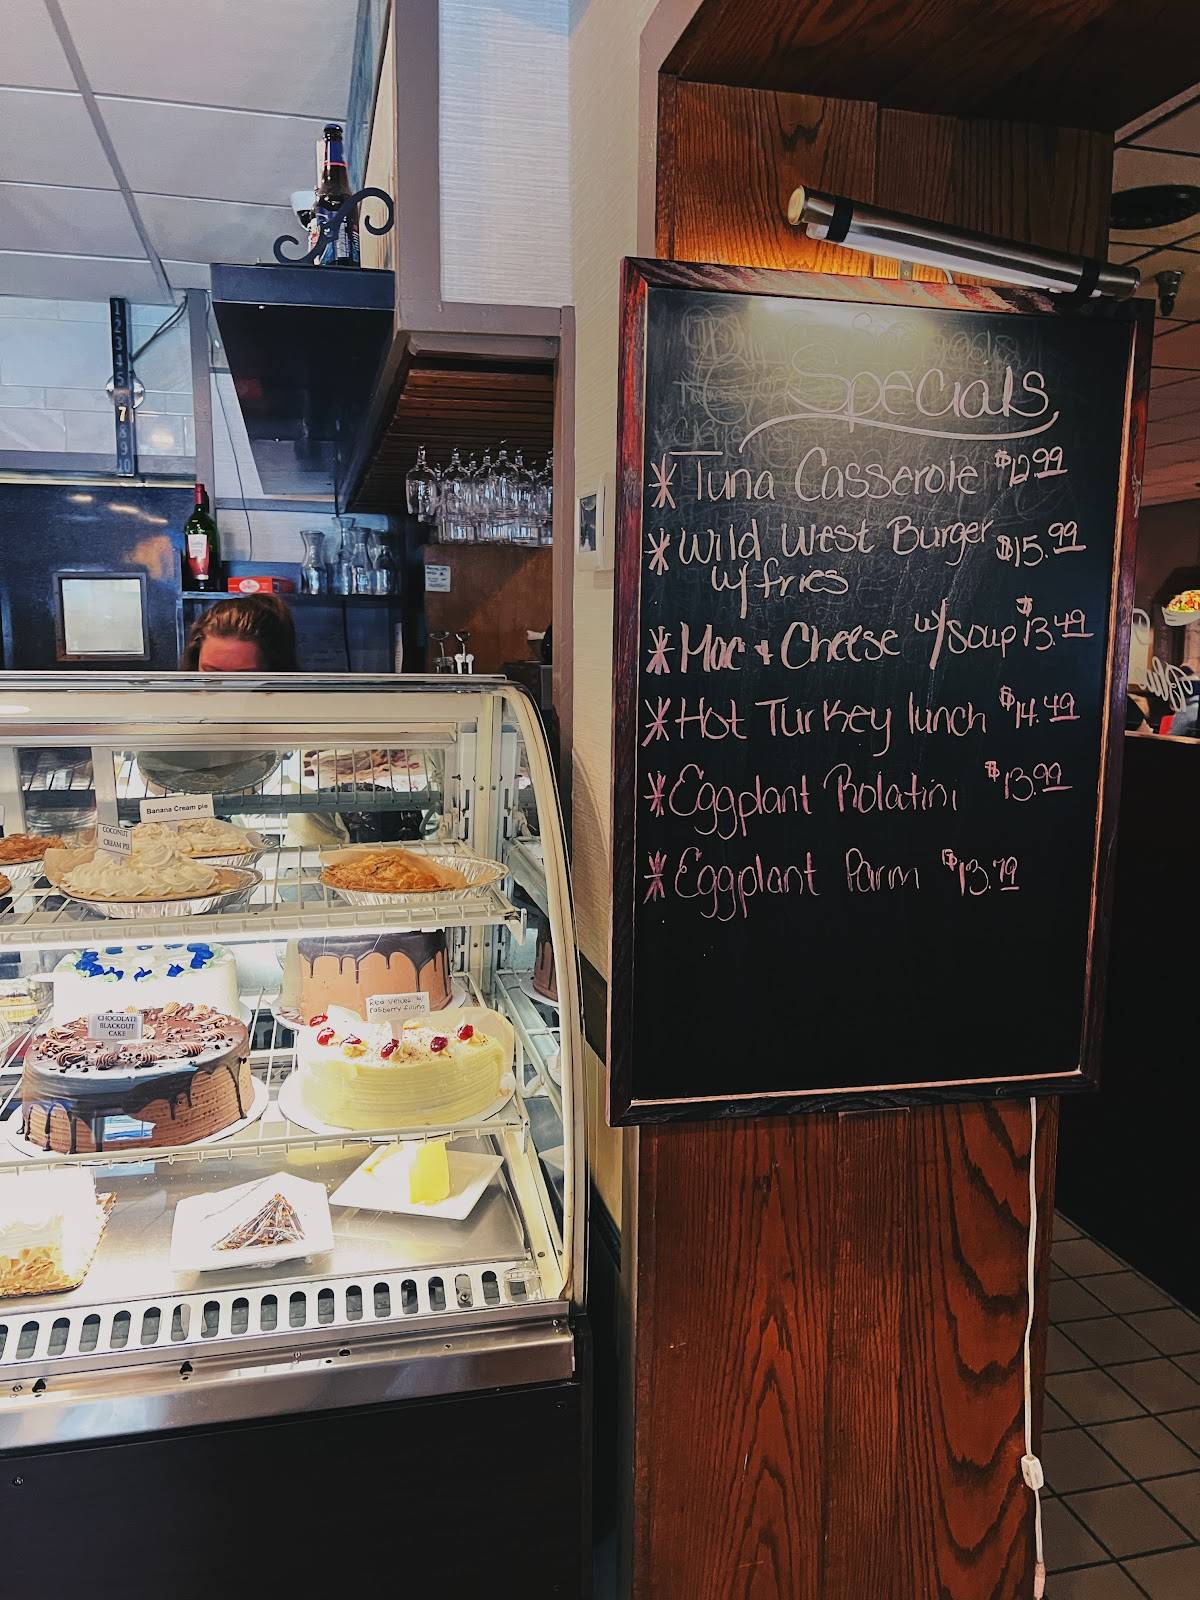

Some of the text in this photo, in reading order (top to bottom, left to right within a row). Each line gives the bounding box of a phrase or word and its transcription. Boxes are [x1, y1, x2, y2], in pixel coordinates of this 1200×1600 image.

[113, 300, 120, 316] 1
[114, 320, 123, 334] 2
[115, 336, 123, 351] 3
[115, 354, 124, 367] 4
[116, 371, 124, 386] 5
[788, 343, 1050, 432] Specials
[118, 406, 127, 423] 7
[119, 424, 127, 439] 8
[120, 441, 128, 456] 9
[117, 459, 131, 473] 10
[669, 449, 775, 501] Tuna
[795, 446, 979, 502] Casserole
[781, 518, 876, 557] West
[886, 515, 994, 566] Burger
[996, 520, 1087, 568] $15.99
[680, 621, 746, 673] Mac
[781, 620, 901, 671] Cheese
[1015, 594, 1095, 651] $13.49
[675, 696, 748, 741] Hot
[998, 684, 1081, 730] $14.49
[669, 760, 1073, 841] Eggplant Rolatini $13.99
[146, 805, 173, 815] Banana
[173, 803, 197, 813] Cream
[102, 826, 129, 838] COCONUT
[103, 839, 131, 851] CREAM PIE
[674, 847, 1020, 923] Eggplant Parm $13.79
